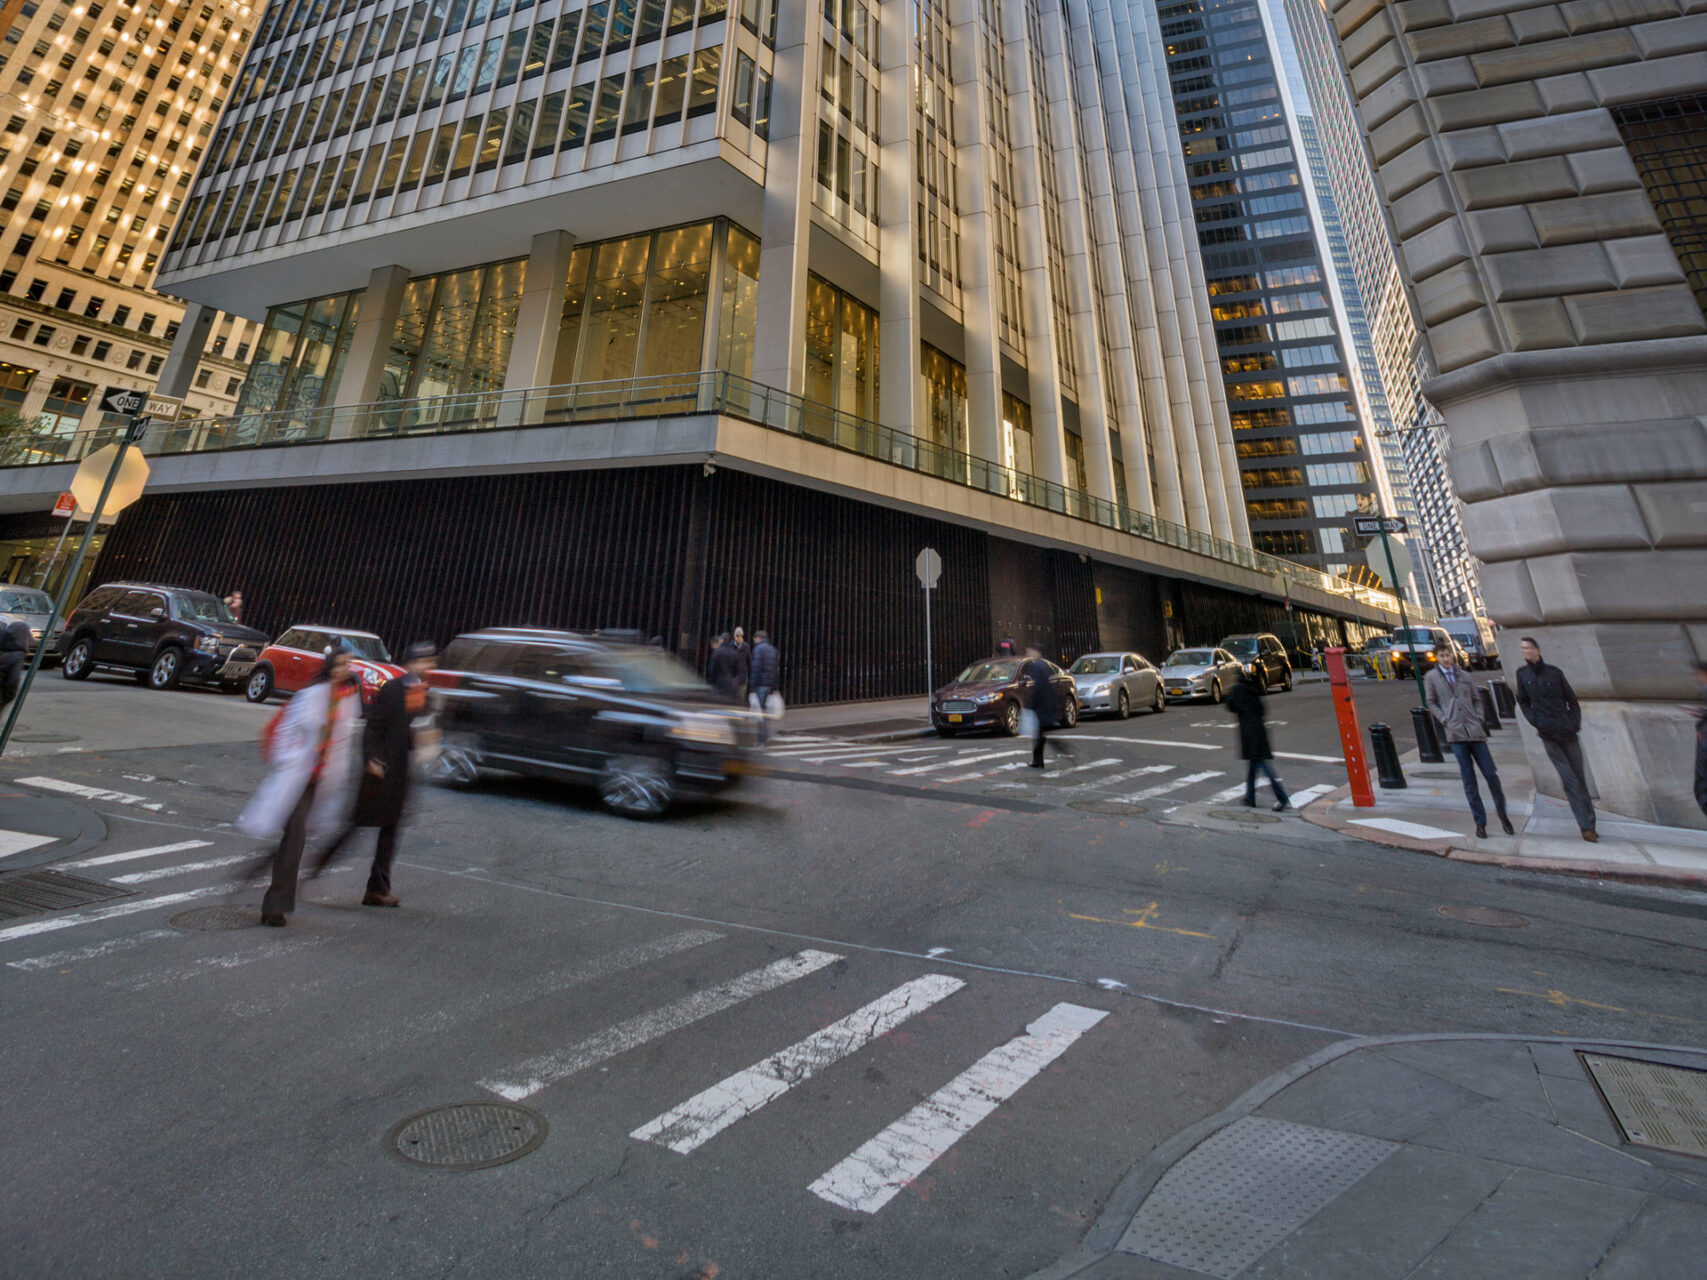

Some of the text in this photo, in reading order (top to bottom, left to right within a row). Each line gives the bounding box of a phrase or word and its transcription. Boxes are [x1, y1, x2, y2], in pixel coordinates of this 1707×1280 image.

[47, 360, 90, 377] THE
[117, 396, 174, 414] ONE WAY
[1362, 520, 1400, 530] ONE WAY
